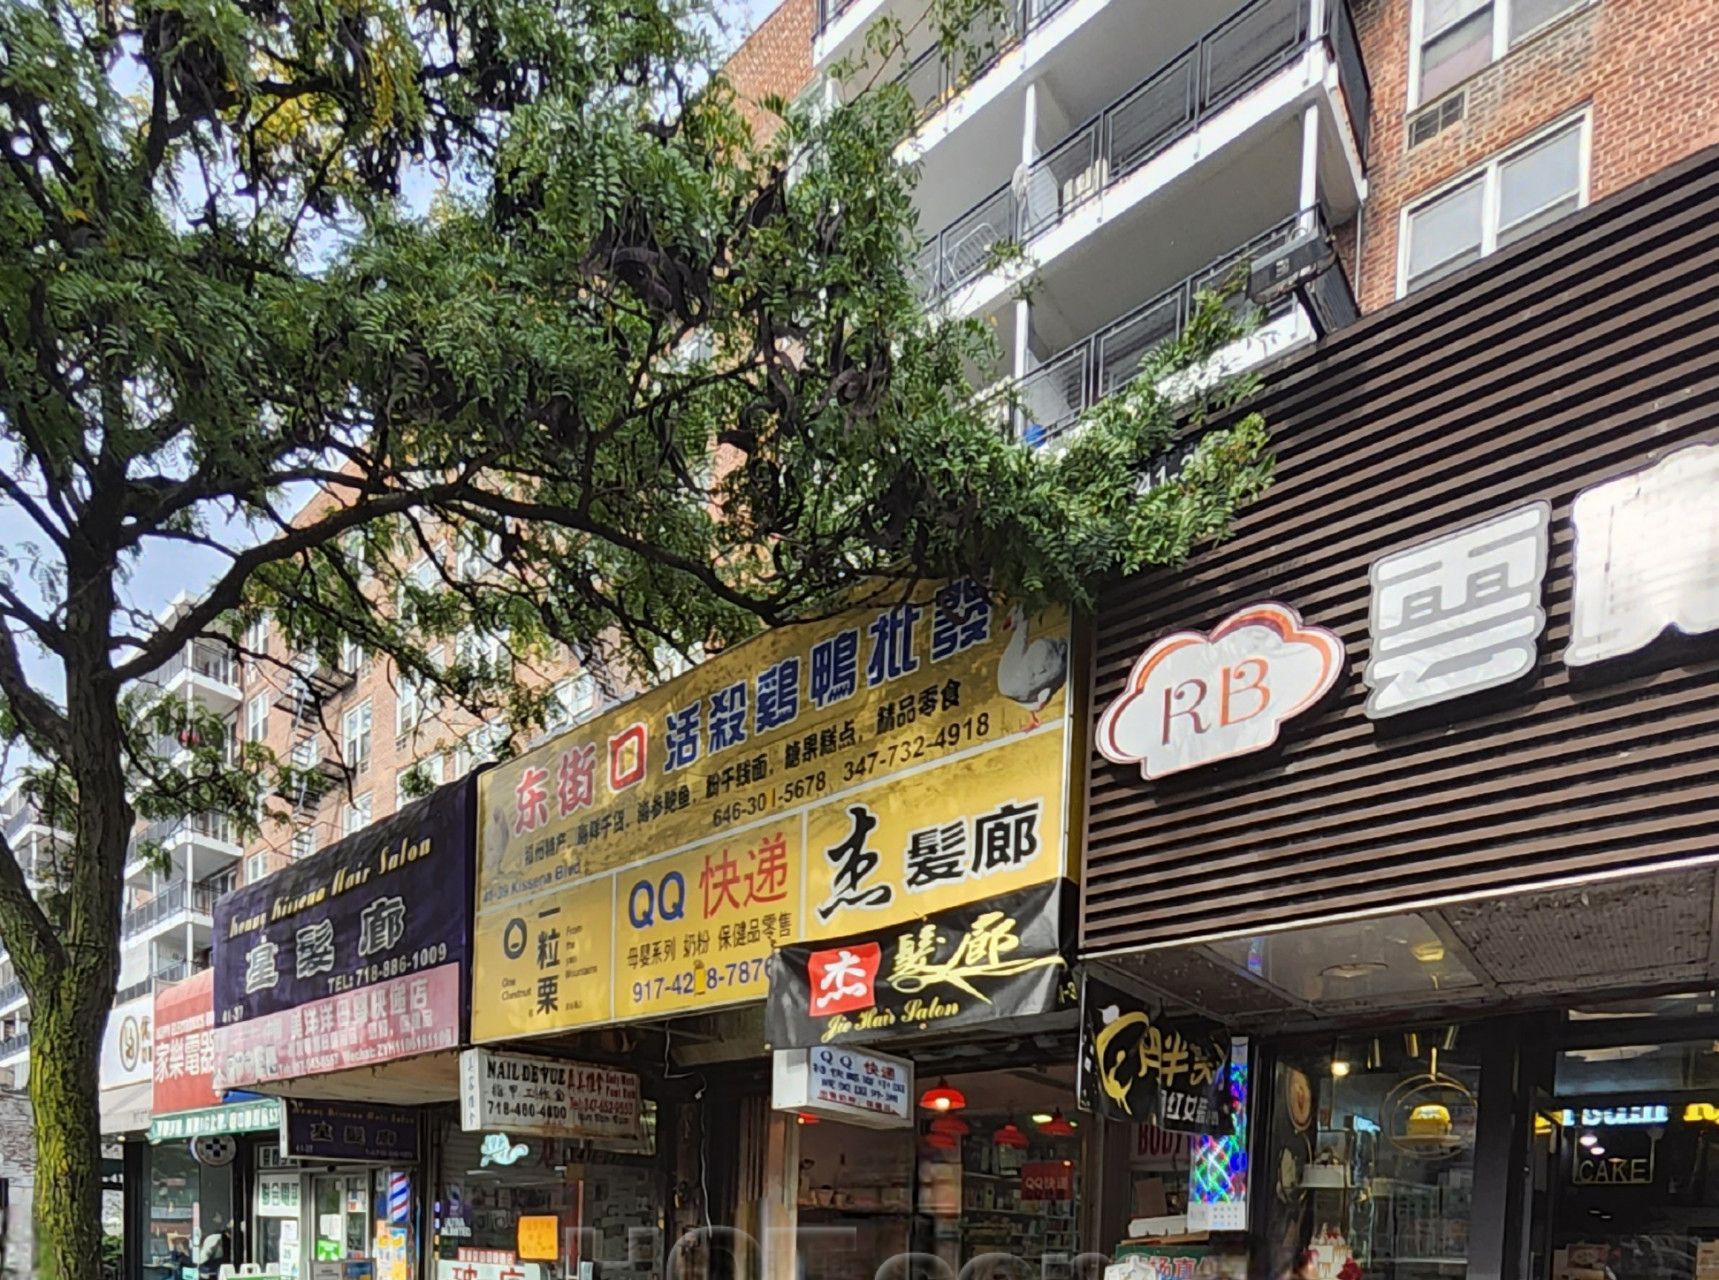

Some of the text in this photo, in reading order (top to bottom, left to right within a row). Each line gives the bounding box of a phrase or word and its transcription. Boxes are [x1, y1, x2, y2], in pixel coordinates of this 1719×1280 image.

[1161, 655, 1273, 747] RB
[514, 722, 648, 837] 东街口
[844, 712, 990, 782] 347-732-4918
[332, 862, 371, 896] Hair
[378, 836, 432, 876] Salon
[629, 830, 788, 928] QQ 快递
[536, 906, 562, 1015] 一粒栗
[683, 929, 710, 959] 奶粉
[820, 995, 960, 1043] Jie Hair Salon
[487, 1057, 521, 1080] NAIL
[1578, 1158, 1648, 1183] CAKE
